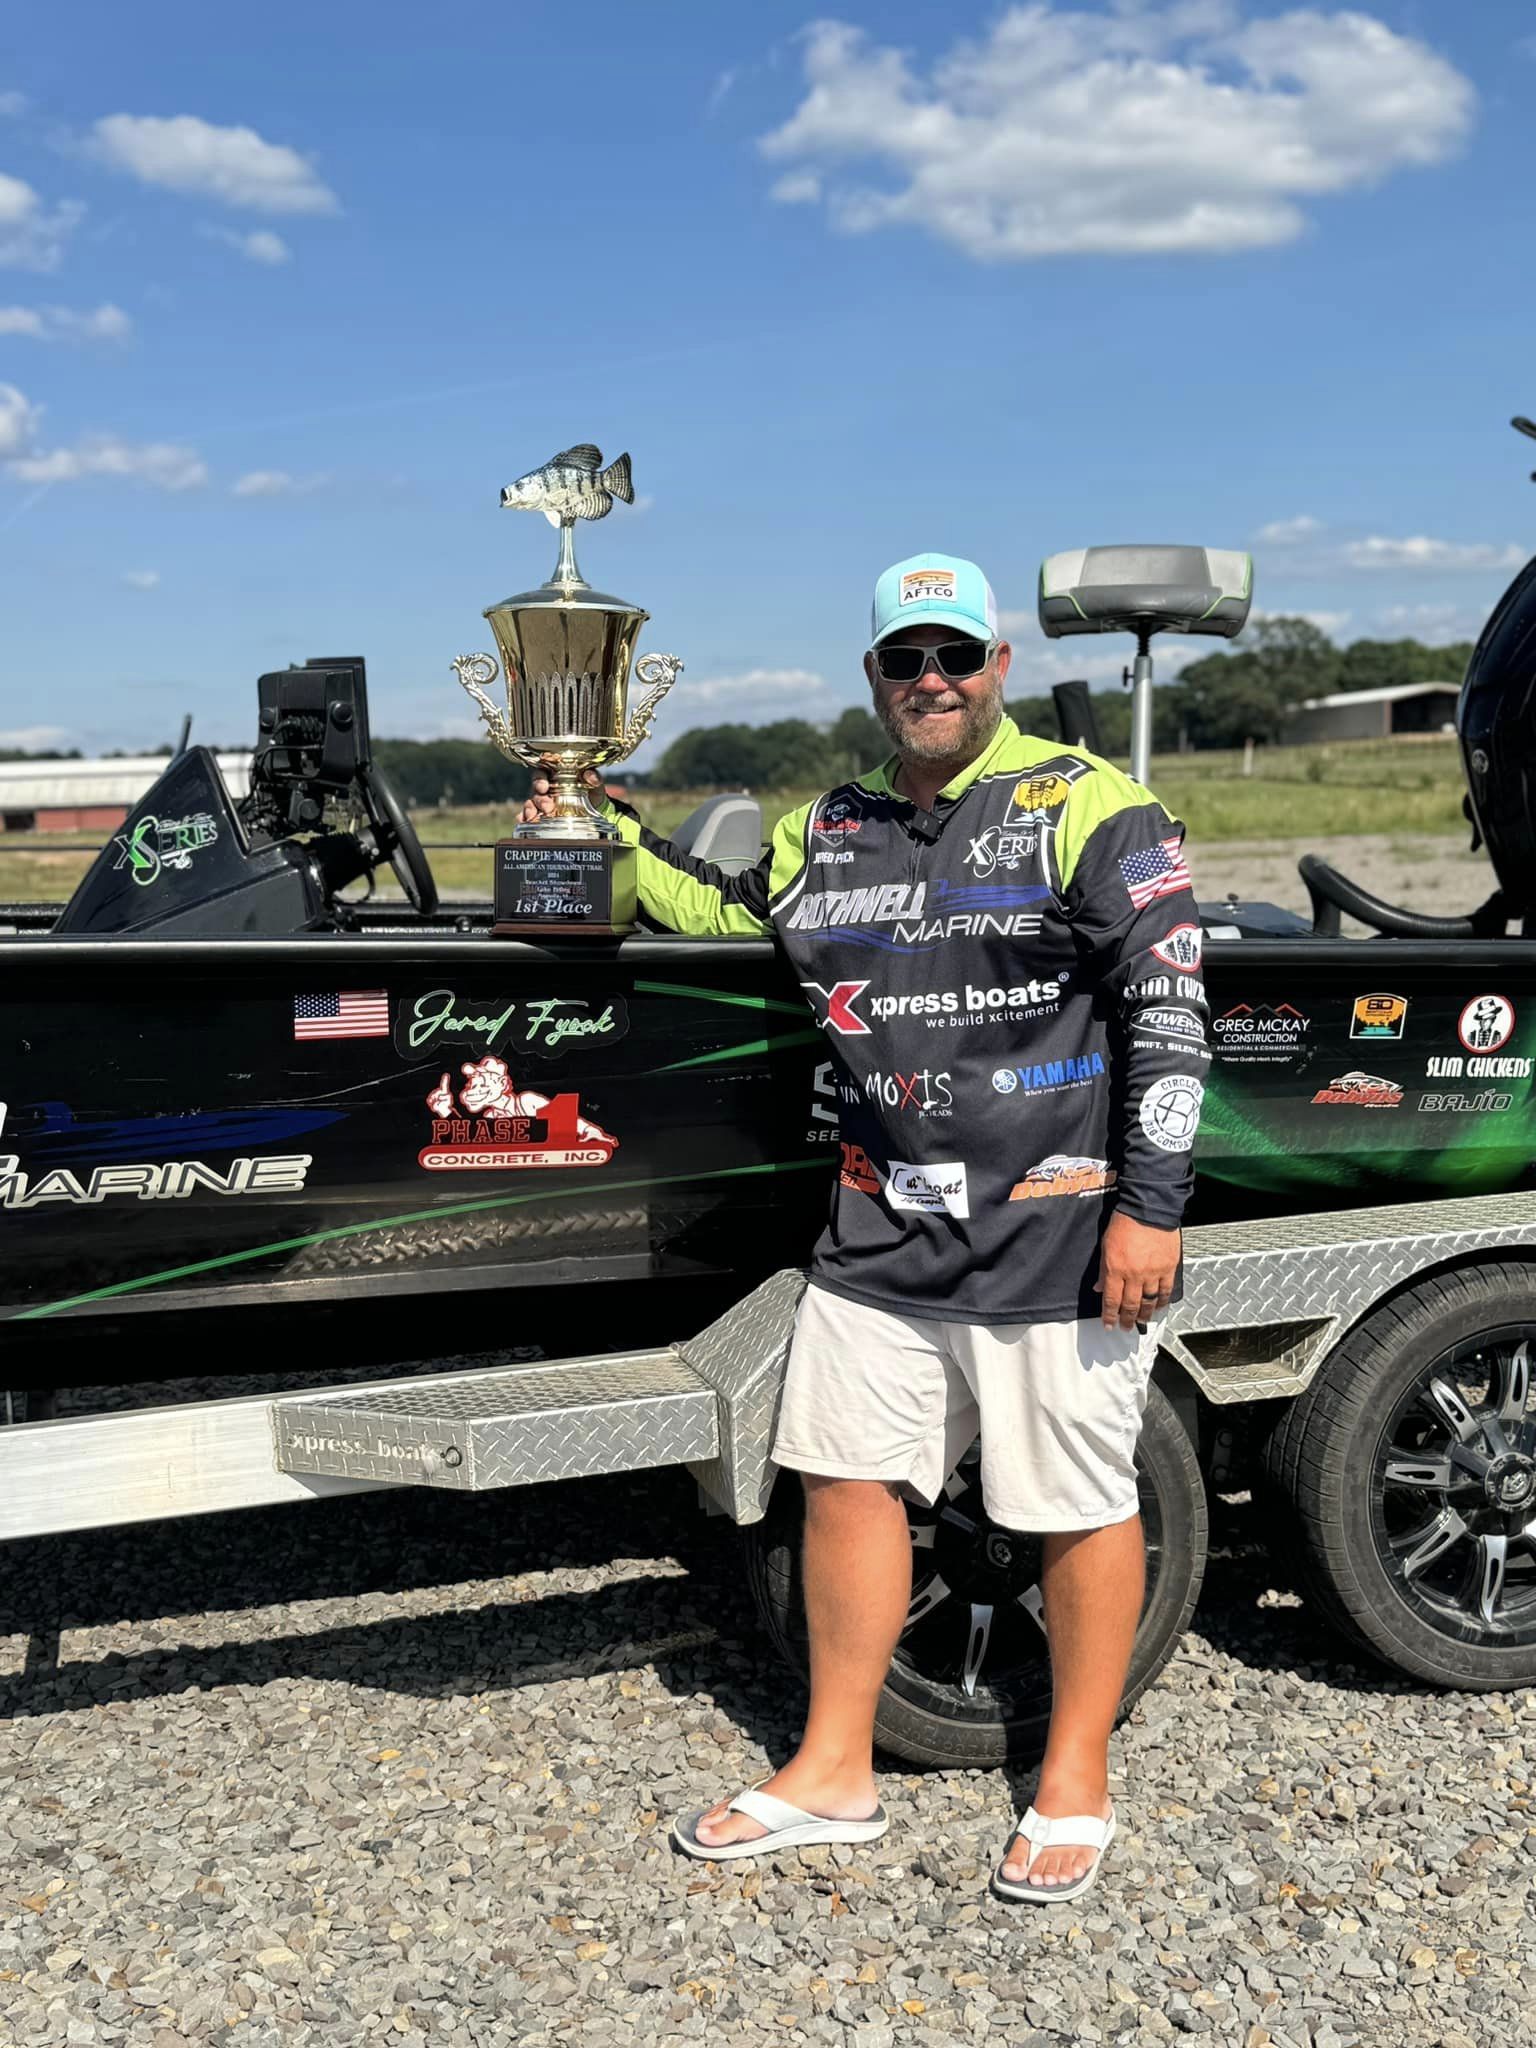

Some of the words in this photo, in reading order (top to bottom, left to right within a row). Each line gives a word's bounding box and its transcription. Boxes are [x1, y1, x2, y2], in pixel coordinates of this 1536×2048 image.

[903, 586, 953, 601] AFTCO
[504, 849, 551, 861] CRAPPIE
[554, 850, 603, 862] MASTERS
[546, 863, 586, 871] TOURNAMENT
[513, 899, 539, 914] 1st
[543, 899, 593, 914] Place
[786, 881, 928, 930] ROTHWELL
[892, 913, 1044, 944] MARINE
[870, 993, 959, 1022] xpress
[926, 1018, 946, 1029] we
[949, 1013, 984, 1027] build
[988, 1002, 1060, 1023] xcitement
[409, 989, 516, 1047] Jared
[1212, 1018, 1255, 1033] GREG
[1257, 1018, 1311, 1033] MCKAY
[1133, 1040, 1164, 1050] SWIFT.
[1222, 1033, 1298, 1043] CONSTRUCTION
[1016, 1052, 1105, 1090] YAMAHA
[1426, 1057, 1463, 1078] SLIM
[1467, 1057, 1532, 1078] CHICKENS
[865, 1069, 953, 1112] MOXIS
[1160, 1078, 1197, 1091] CIRCLE
[431, 1119, 531, 1144] PHASE
[563, 1151, 606, 1163] INC.
